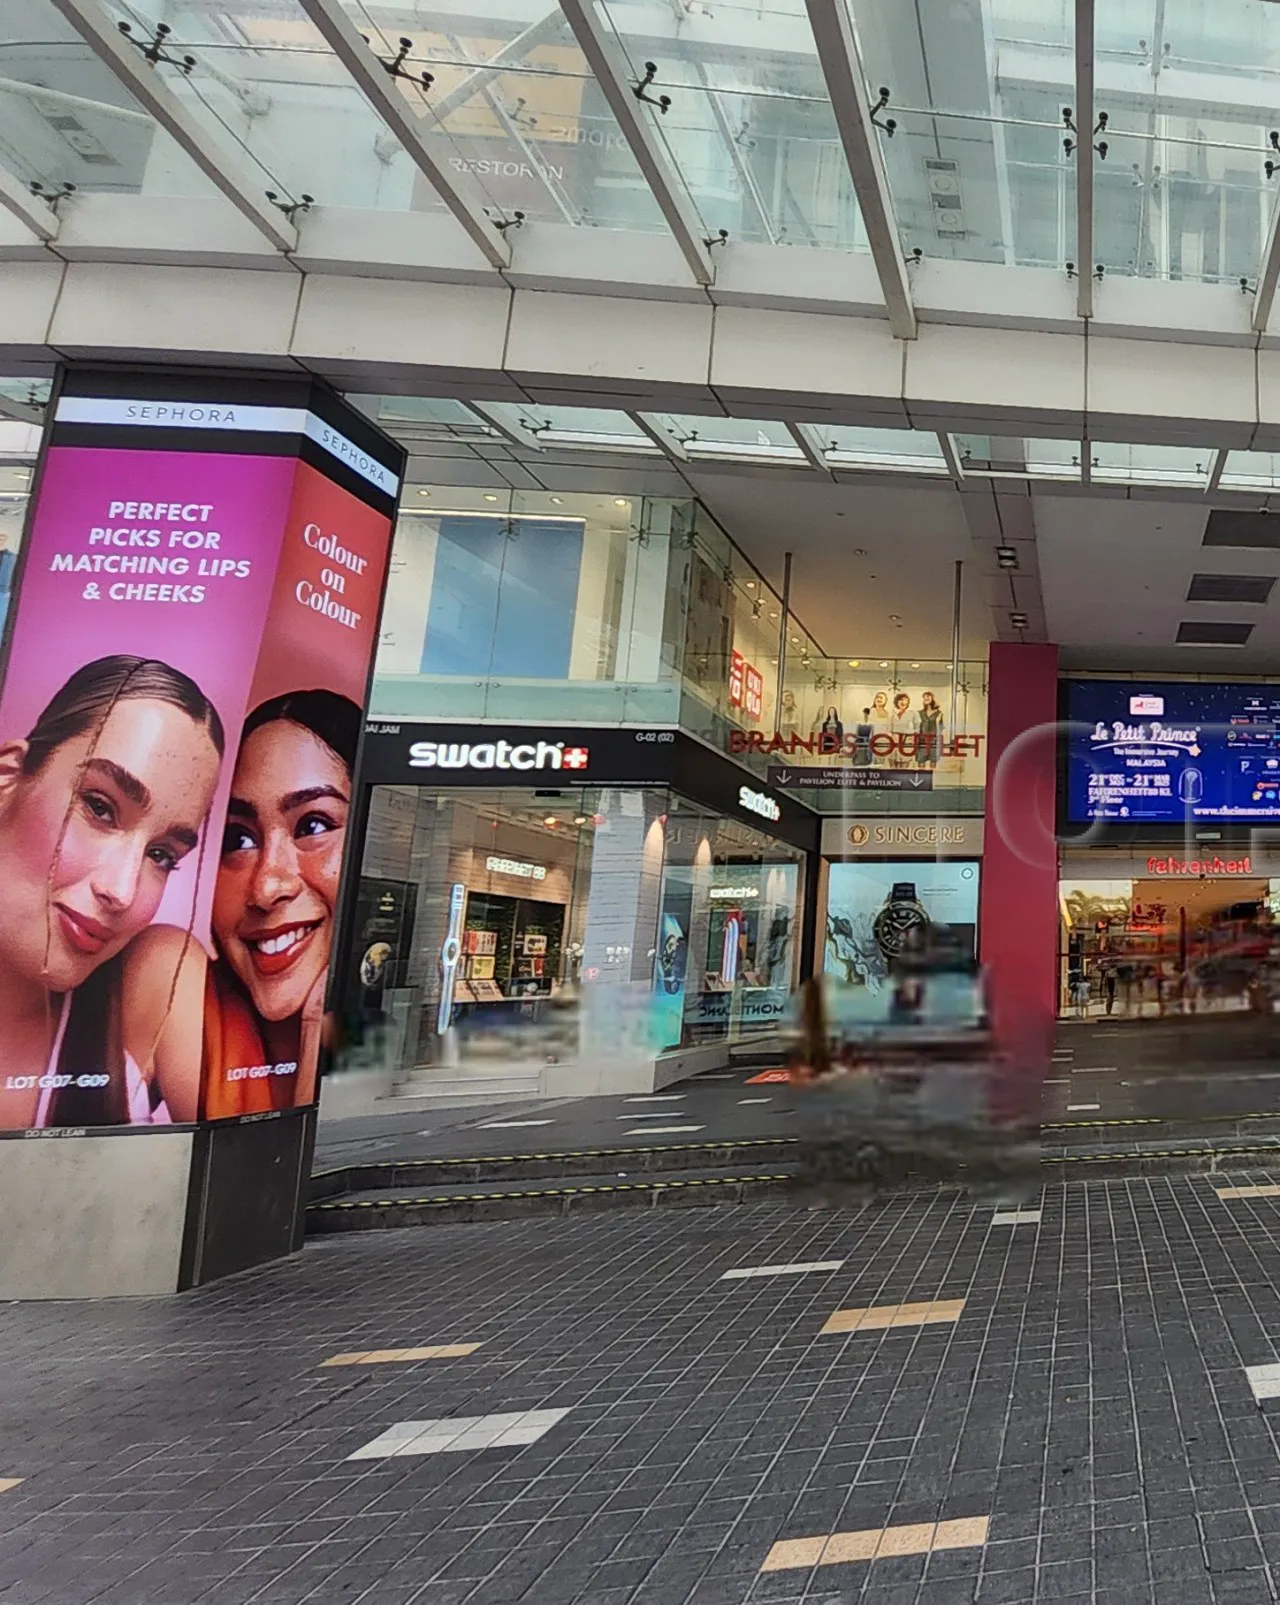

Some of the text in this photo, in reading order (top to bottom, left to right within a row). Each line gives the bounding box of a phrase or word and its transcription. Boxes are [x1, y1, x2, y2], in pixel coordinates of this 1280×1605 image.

[126, 405, 236, 424] SEPHORA
[321, 428, 387, 483] SEPHORA
[109, 501, 213, 522] PERFECT
[88, 528, 221, 550] PICKS FOR
[303, 522, 368, 577] Colour
[49, 554, 251, 578] MATCHING LIPS
[320, 566, 347, 593] on
[82, 583, 206, 603] & CHEEKS
[295, 580, 362, 631] Colour
[635, 732, 675, 744] G-02 (02)
[1090, 721, 1197, 742] Le Petit Prince
[408, 740, 564, 770] swatch
[729, 730, 986, 759] BRANDS OUTLET
[799, 778, 836, 786] PAVILION
[822, 771, 866, 779] UNDERPASS
[874, 825, 966, 845] SINCERE
[1147, 856, 1253, 874] fahrenheit
[7, 1073, 109, 1090] LOT G07-G09
[227, 1062, 297, 1081] LOT G07-G09
